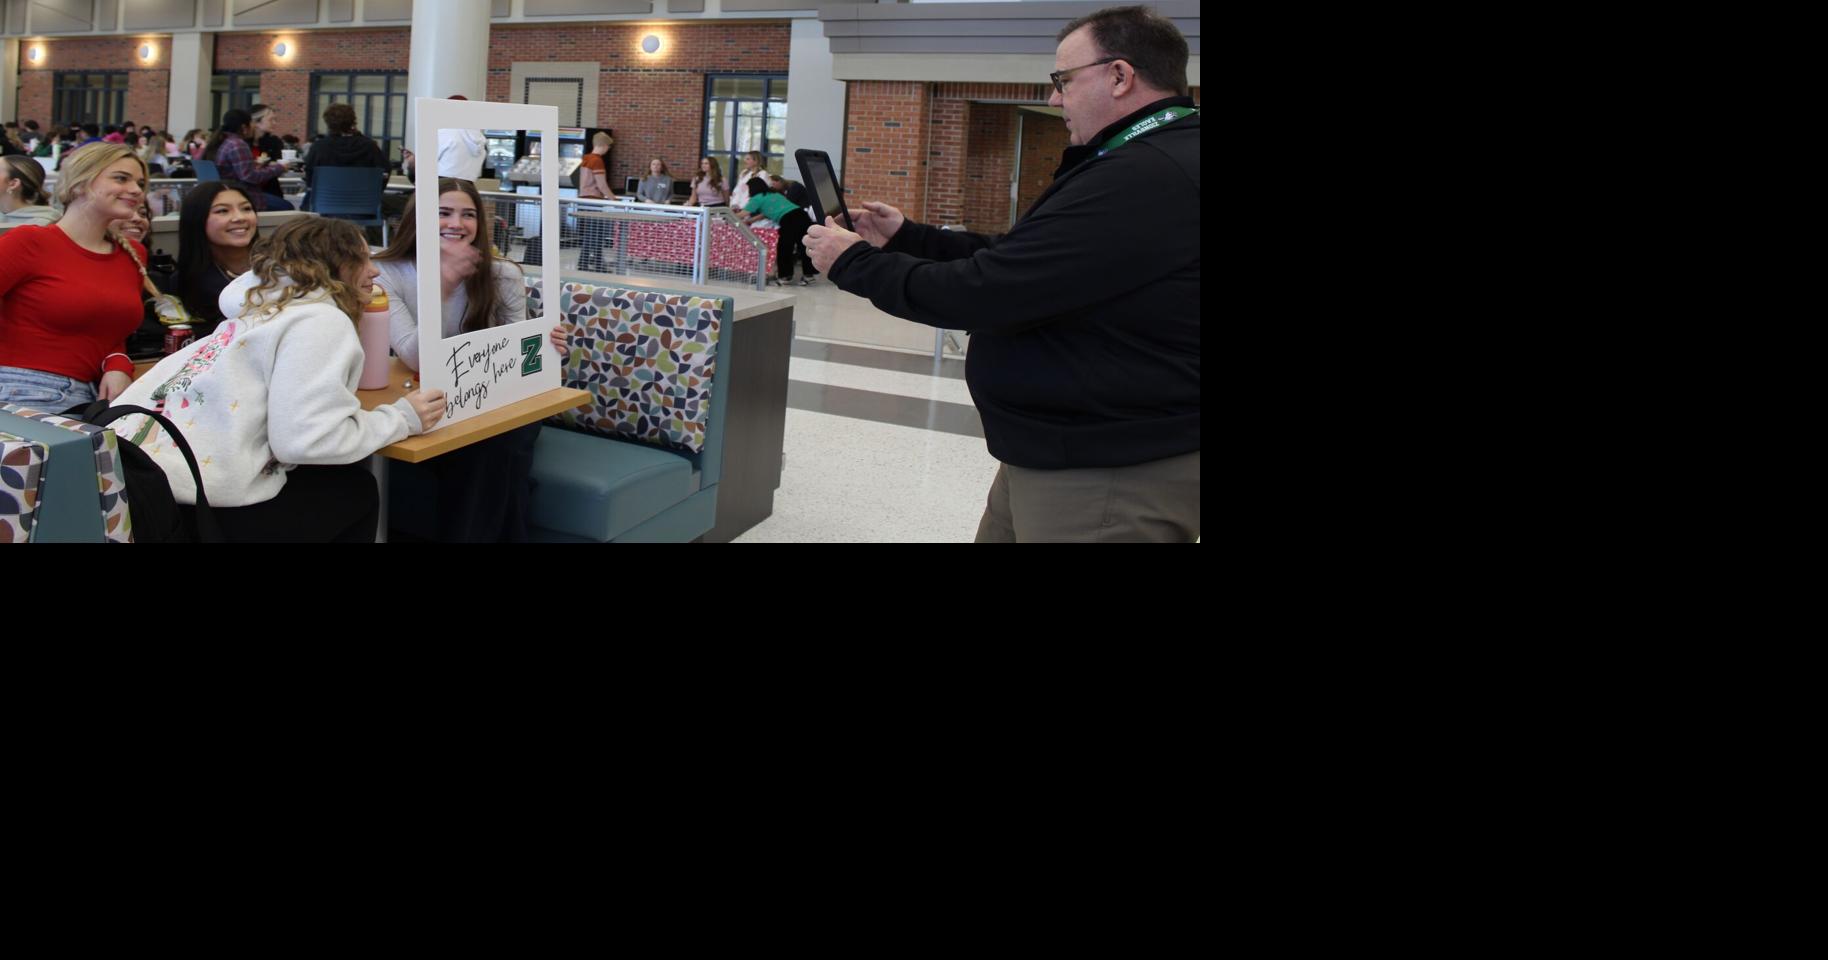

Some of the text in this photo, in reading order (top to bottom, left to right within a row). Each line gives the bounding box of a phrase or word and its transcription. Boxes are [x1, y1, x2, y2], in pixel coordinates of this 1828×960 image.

[1123, 121, 1160, 141] ZIONSVILLE
[1131, 116, 1156, 131] EAGLES
[445, 337, 510, 388] Everyone
[520, 333, 542, 377] Z
[445, 357, 517, 419] belongs here
